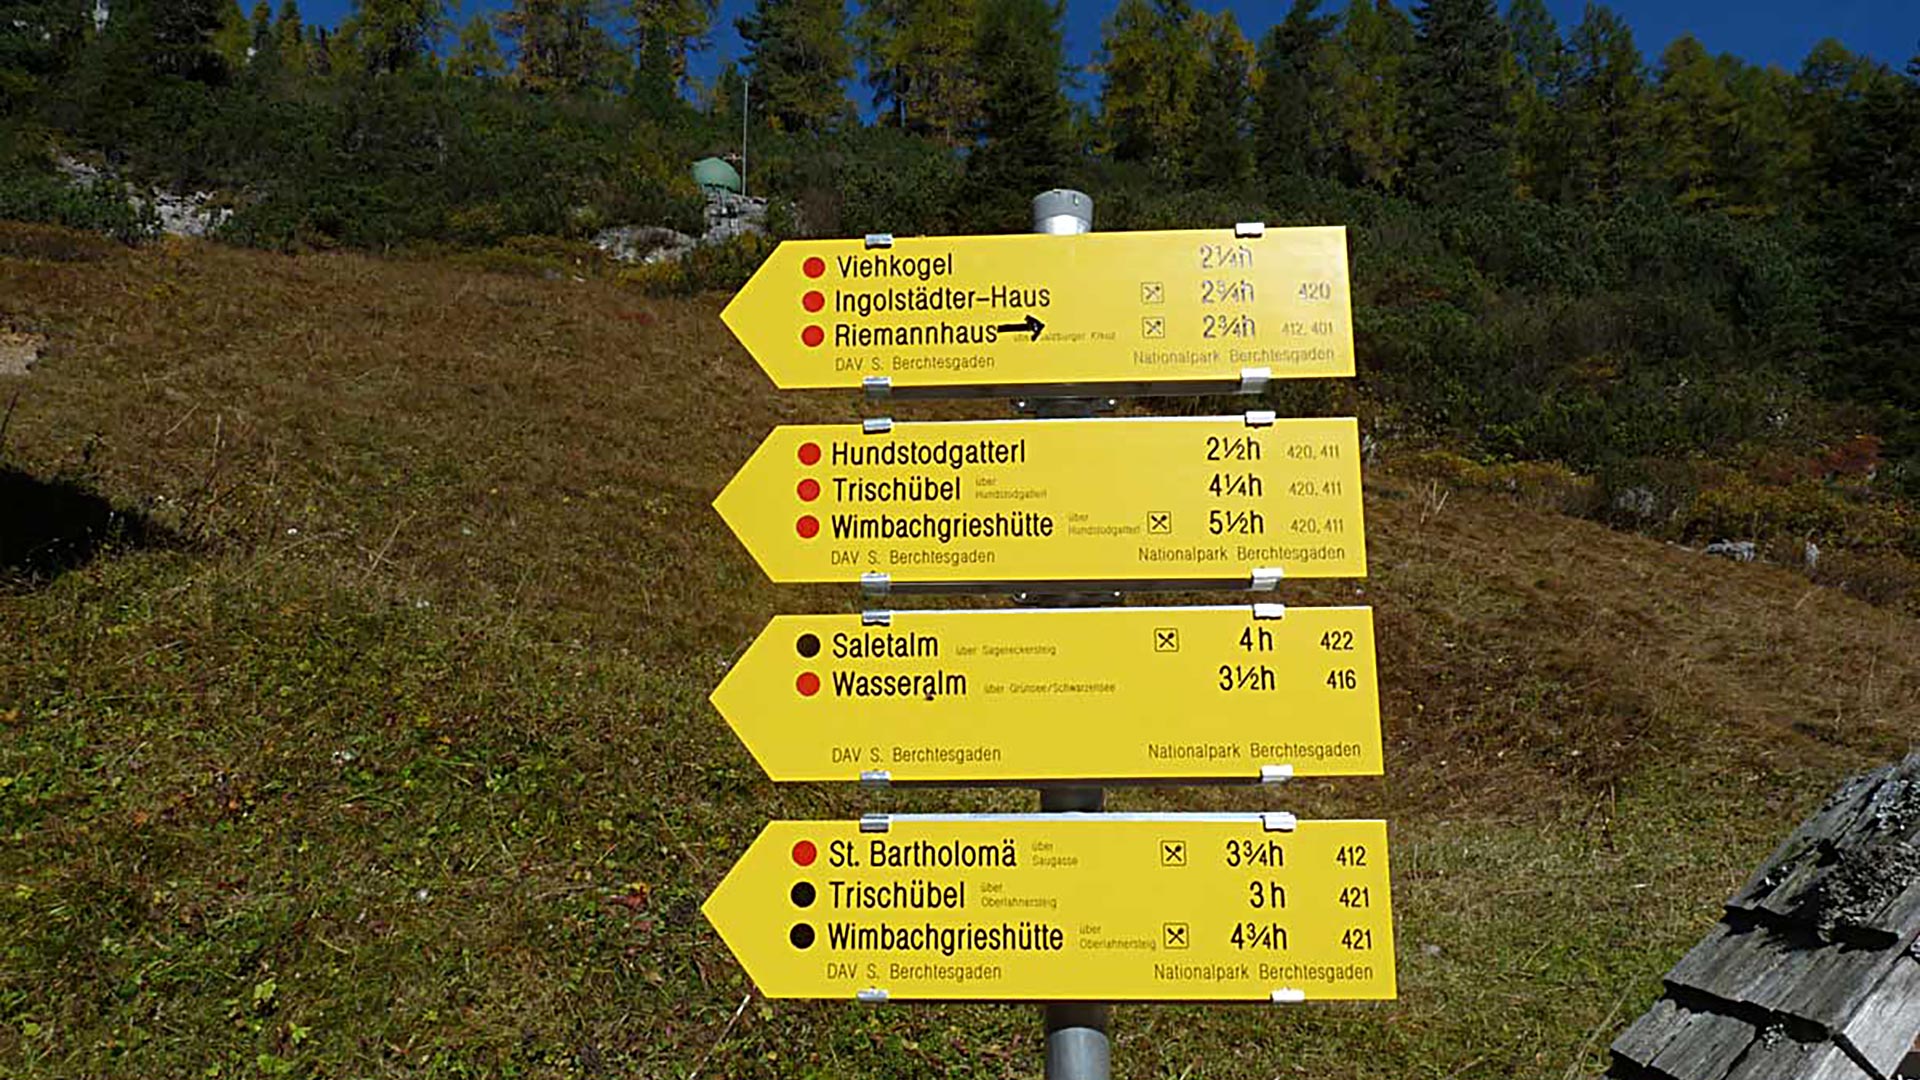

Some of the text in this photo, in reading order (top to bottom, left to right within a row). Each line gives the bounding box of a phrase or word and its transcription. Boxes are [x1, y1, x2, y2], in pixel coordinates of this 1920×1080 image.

[836, 252, 953, 282] Viehkogel
[1298, 282, 1331, 301] 420
[835, 321, 998, 348] Riemannhaus
[1202, 314, 1256, 339] 2¾h
[1310, 320, 1334, 336] 401
[835, 354, 995, 372] DAV S. Berchtesgaden
[1133, 347, 1335, 366] Nationalpark Berchtesgaden
[832, 438, 1025, 470] Hundstodgatterl
[1206, 436, 1261, 461] 2½h
[1286, 444, 1340, 461] 420, 411
[832, 475, 961, 503] Trischübel
[1208, 472, 1263, 498] 4¼h
[1288, 480, 1342, 497] 420, 411
[831, 510, 1054, 544] Wimbachgrieshütte
[1209, 509, 1264, 536] 5½h
[1290, 517, 1344, 535] 420, 411
[831, 549, 996, 567] DAV S. Berchtesgaden
[1138, 545, 1345, 564] Nationalpark Berchtesgaden
[832, 631, 939, 659] Saletalm
[1320, 630, 1354, 651] 422
[832, 669, 967, 697] Wasseralm
[1218, 664, 1276, 692] 3½h
[1326, 668, 1357, 690] 416
[831, 746, 1001, 765] DAV S. Berchtesgaden
[1148, 741, 1361, 762] Nationalpark Berchtesgaden
[829, 838, 1018, 868] St. Bartholomä
[1225, 839, 1284, 868] 3¾h
[1335, 845, 1367, 867] 412
[828, 879, 965, 909] Trischübel
[1338, 886, 1370, 908] 421
[827, 921, 1064, 957] Wimbachgrieshütte
[1230, 922, 1288, 951] 4¾h
[1341, 928, 1372, 950] 421
[827, 962, 1002, 984] DAV S. Berchtesgaden
[1154, 962, 1374, 984] Nationalpark Berchtesgaden
